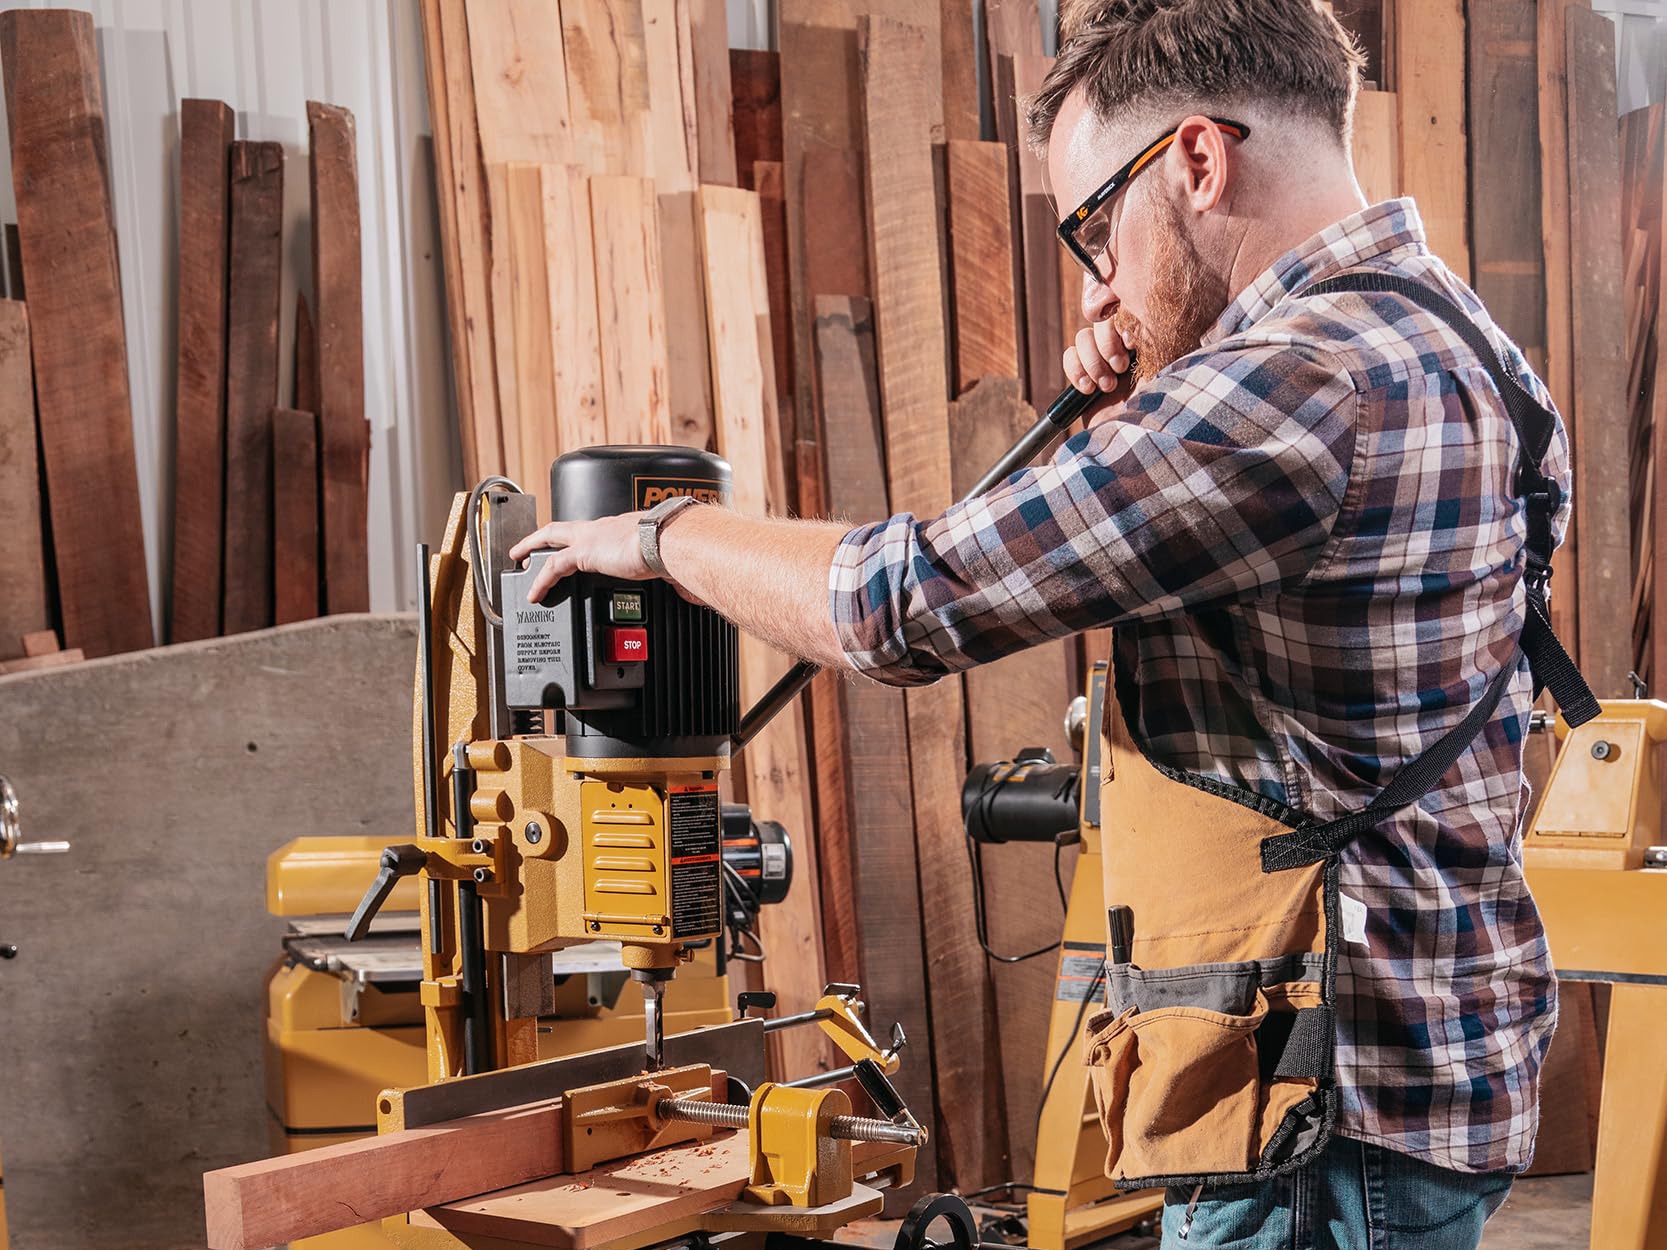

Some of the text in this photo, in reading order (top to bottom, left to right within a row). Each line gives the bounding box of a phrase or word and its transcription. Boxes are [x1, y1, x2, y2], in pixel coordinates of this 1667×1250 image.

[616, 601, 639, 610] START
[516, 610, 555, 624] WARNING
[624, 640, 642, 650] STOP
